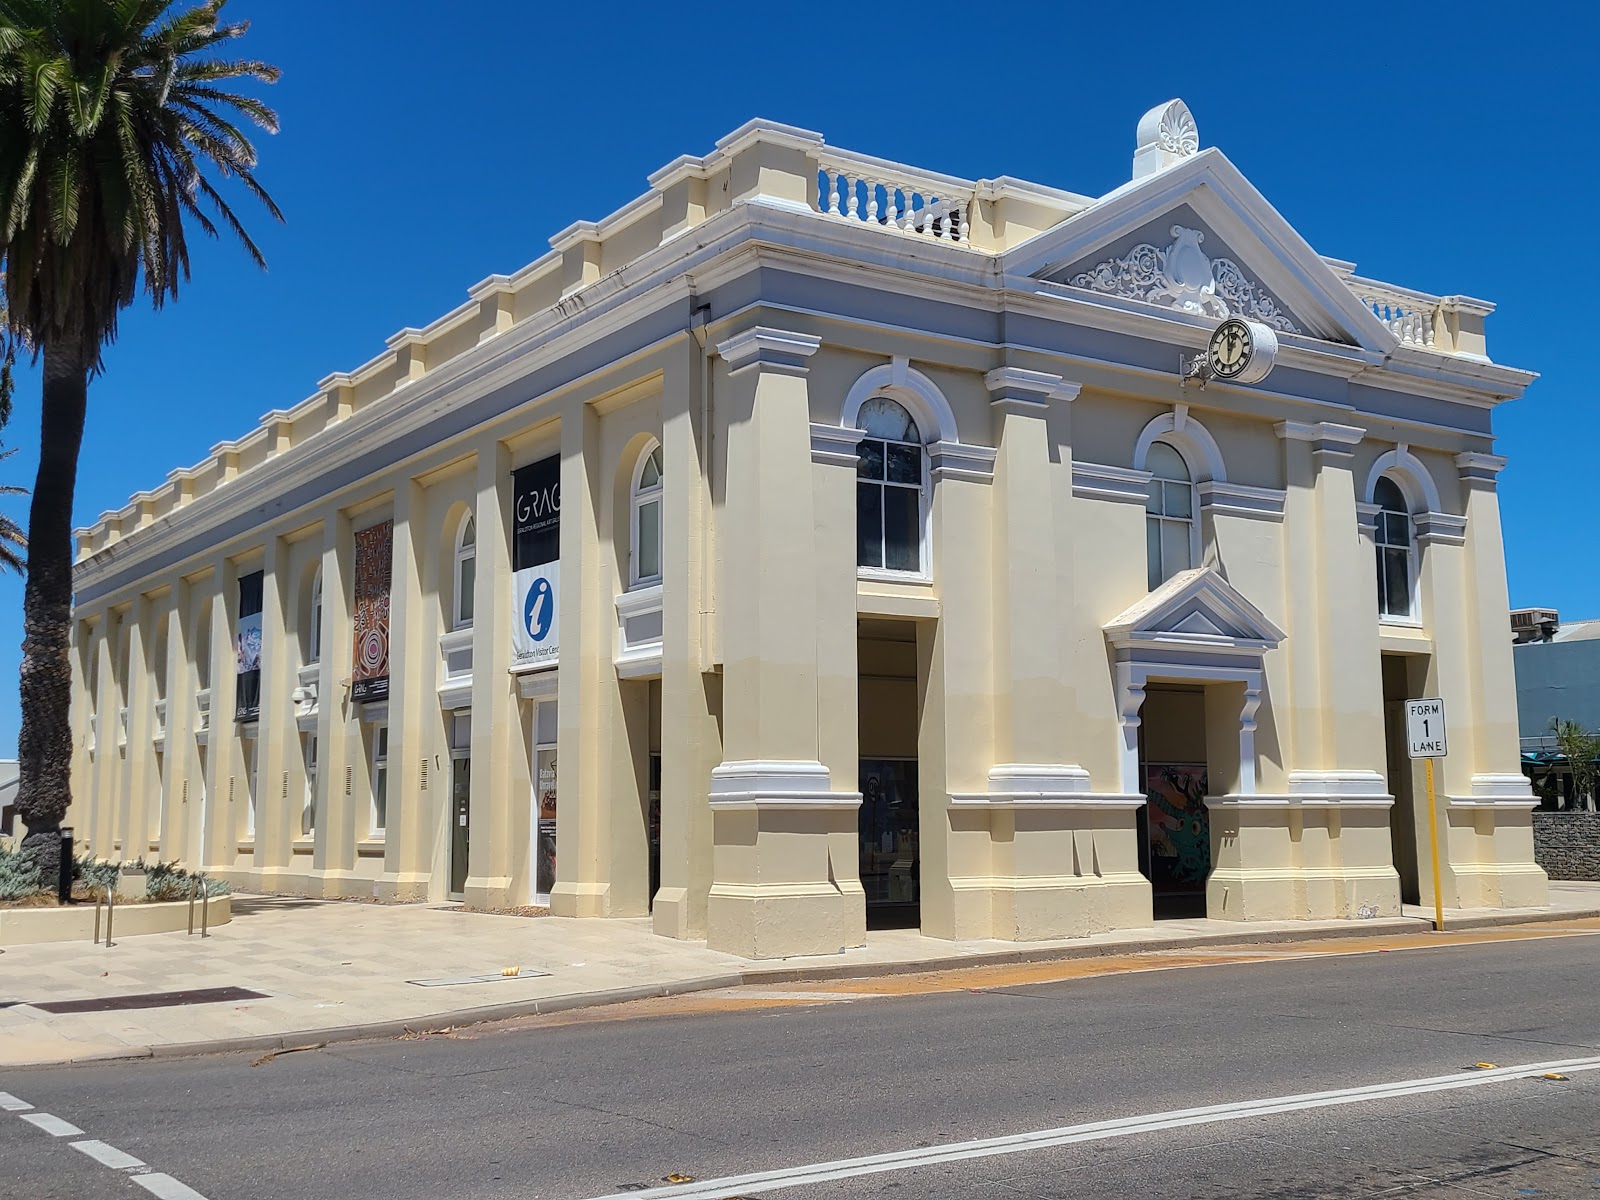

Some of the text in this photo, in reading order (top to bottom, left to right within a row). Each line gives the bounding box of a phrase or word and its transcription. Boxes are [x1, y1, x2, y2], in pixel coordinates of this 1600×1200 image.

[1411, 704, 1439, 716] FORM
[1423, 719, 1429, 737] 1
[1413, 741, 1442, 752] LANE
